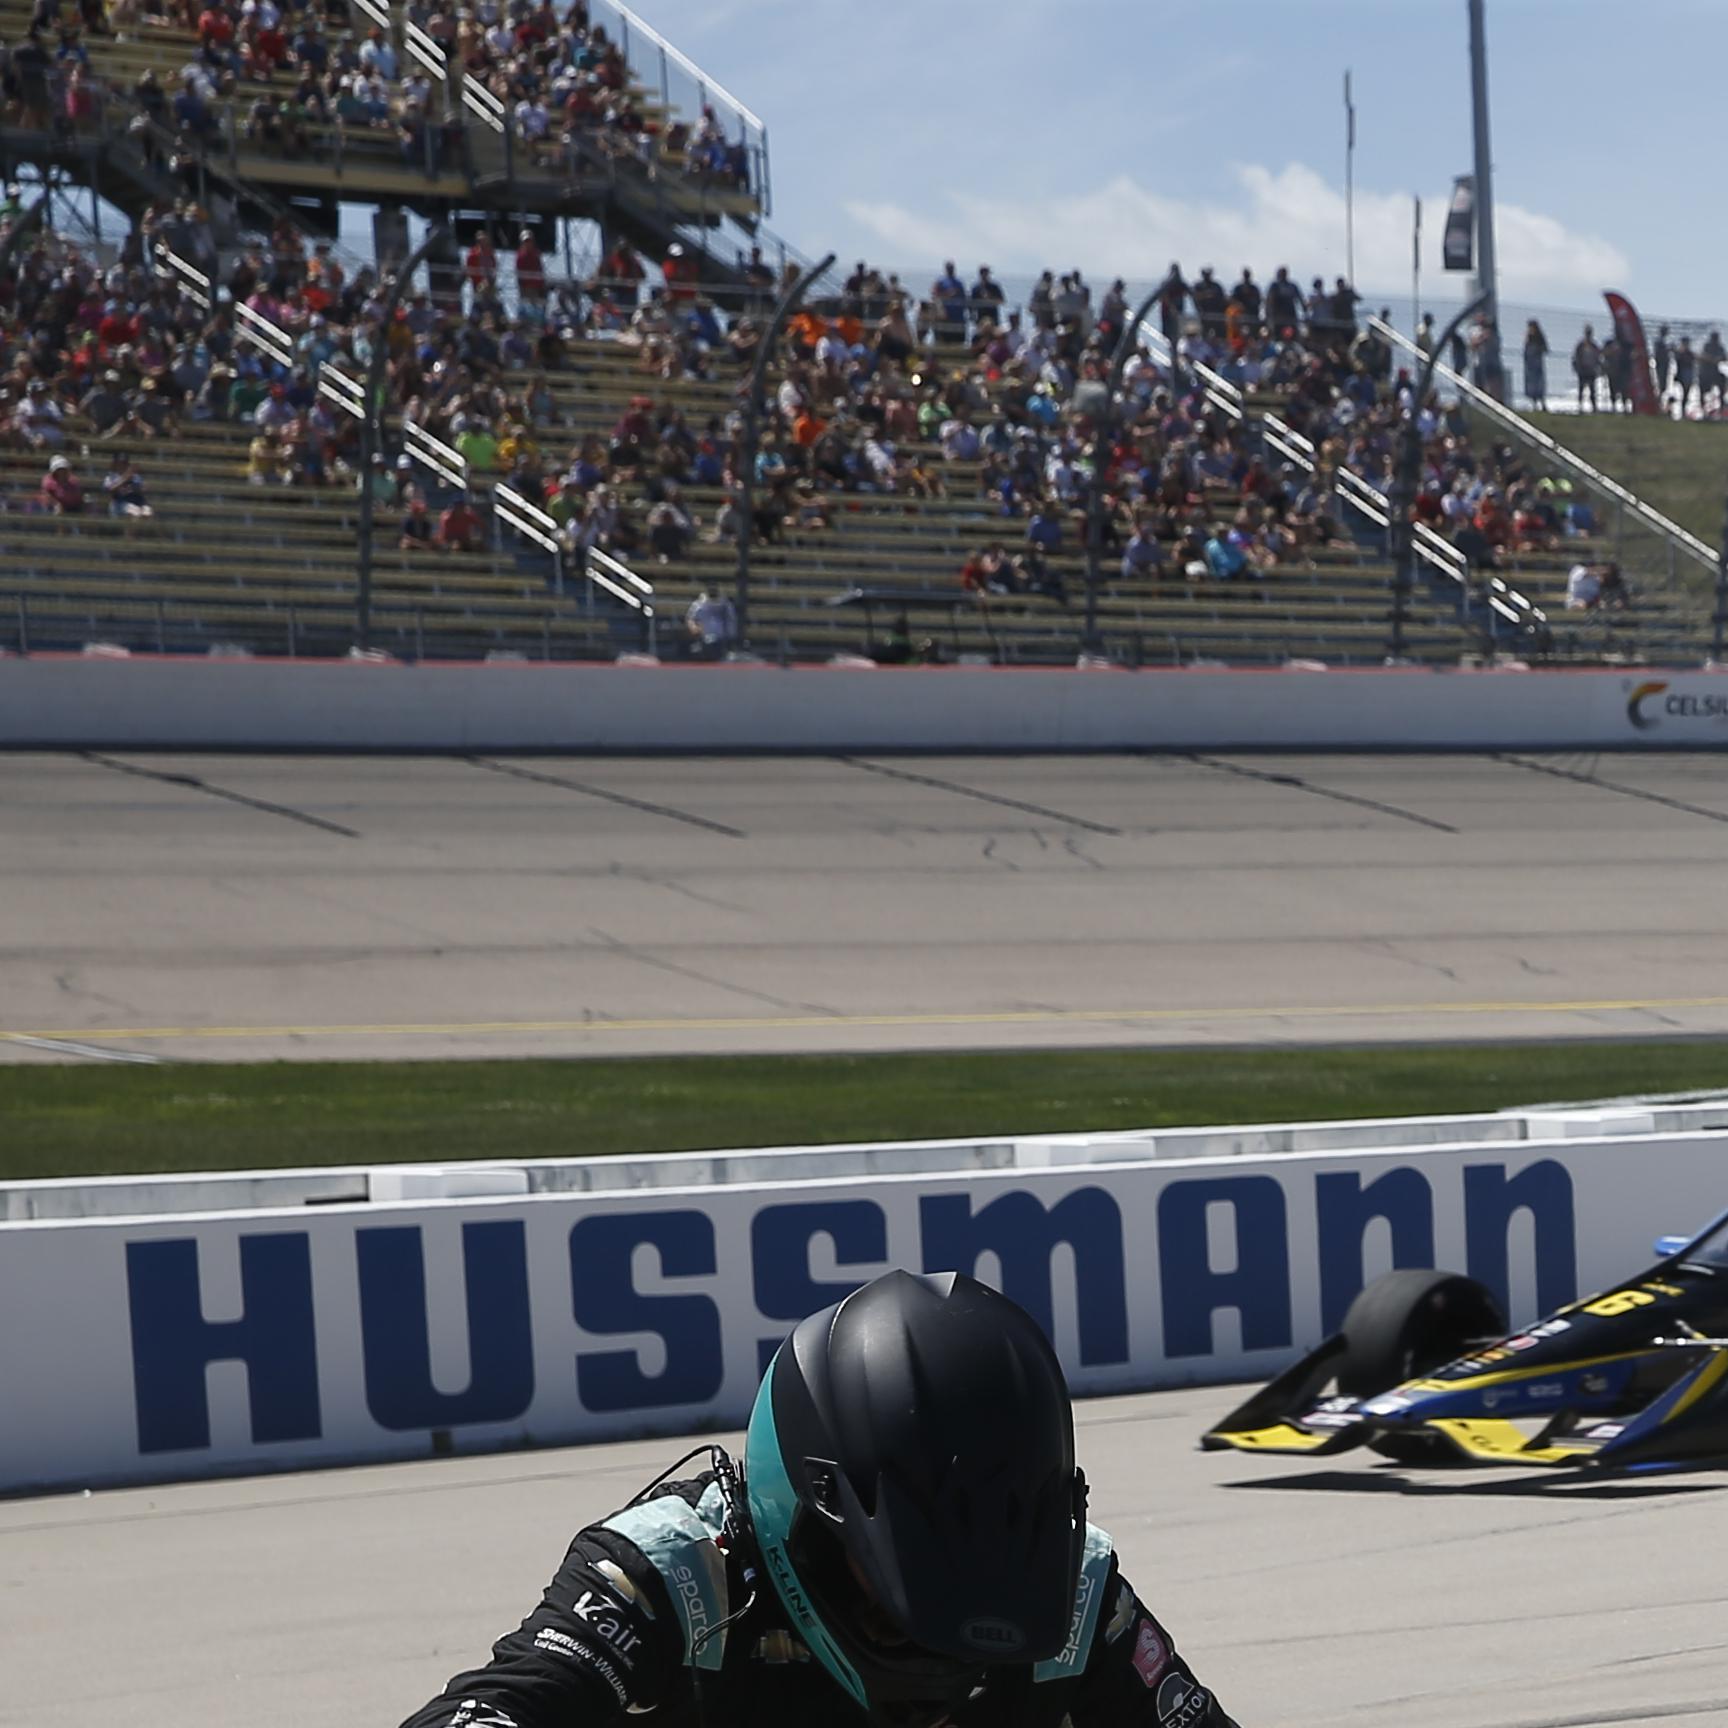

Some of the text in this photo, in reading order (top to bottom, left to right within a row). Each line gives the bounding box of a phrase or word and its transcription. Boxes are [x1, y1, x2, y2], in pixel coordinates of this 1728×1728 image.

[1583, 1289, 1656, 1317] 6
[767, 1545, 819, 1630] K-LINE
[970, 1624, 1017, 1646] BELL
